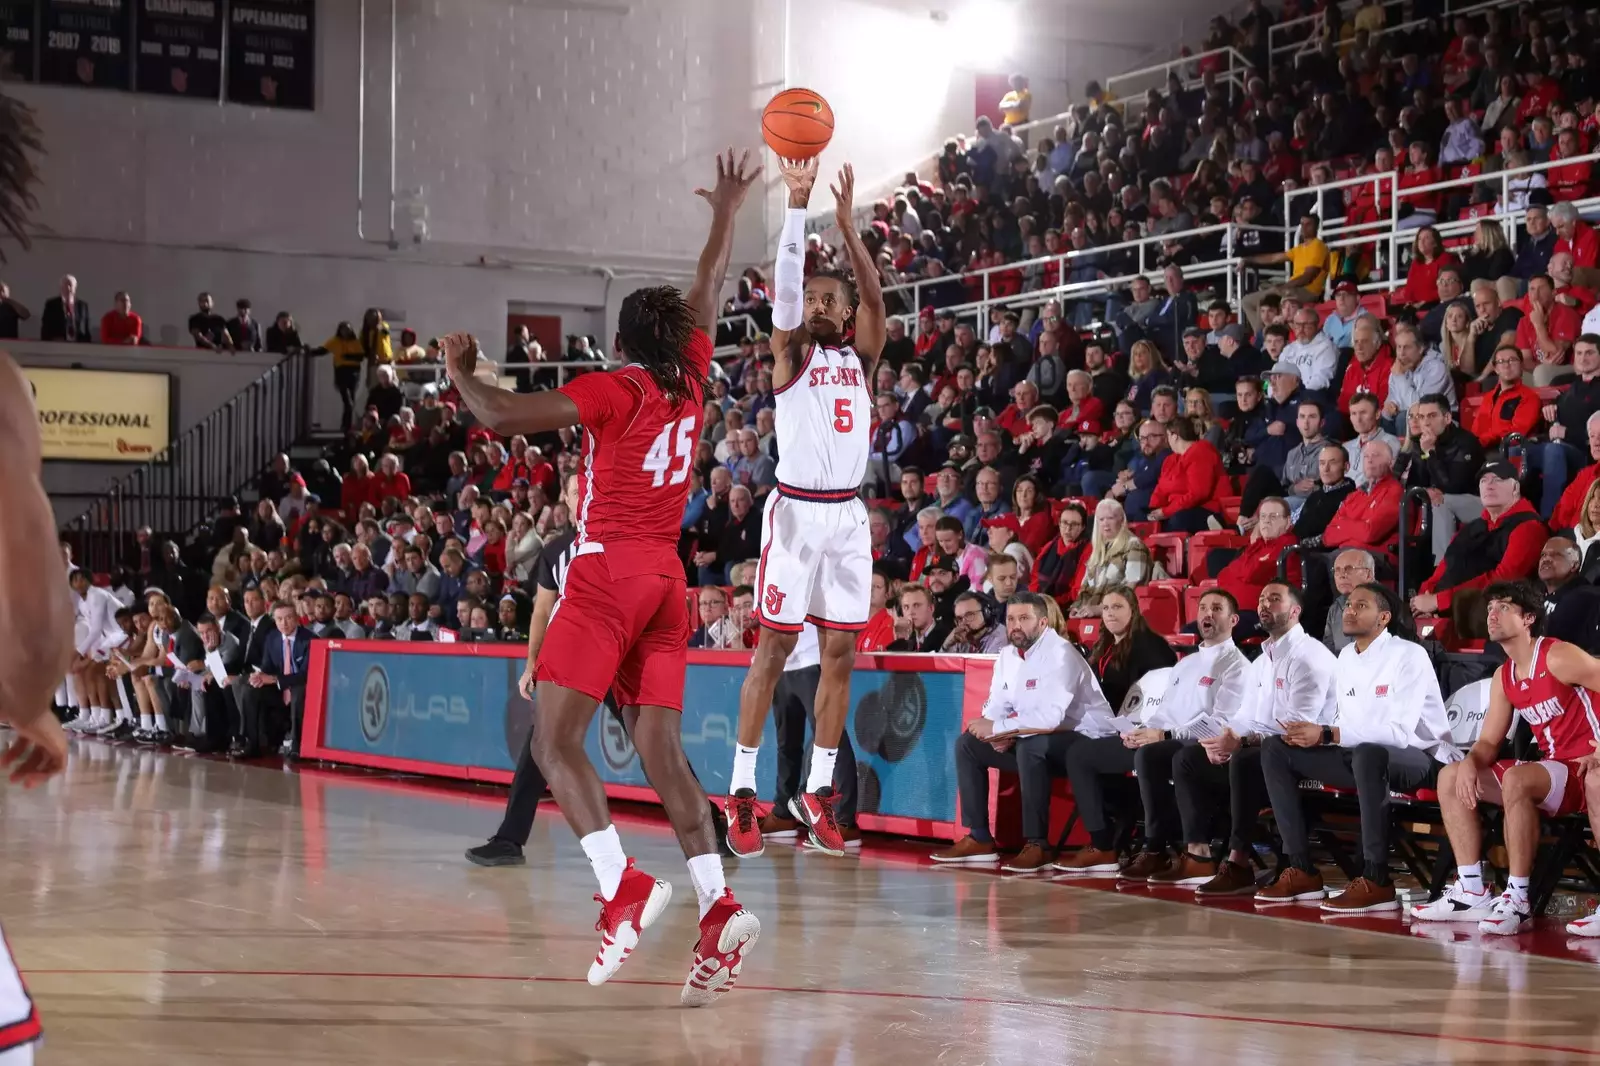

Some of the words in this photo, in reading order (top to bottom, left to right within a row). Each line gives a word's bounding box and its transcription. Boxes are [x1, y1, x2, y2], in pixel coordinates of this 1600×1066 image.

[232, 7, 308, 30] APPEARANCES
[48, 30, 80, 50] 2007
[38, 410, 151, 428] ROFESSIONAL
[833, 398, 854, 433] 5
[641, 414, 696, 488] 45
